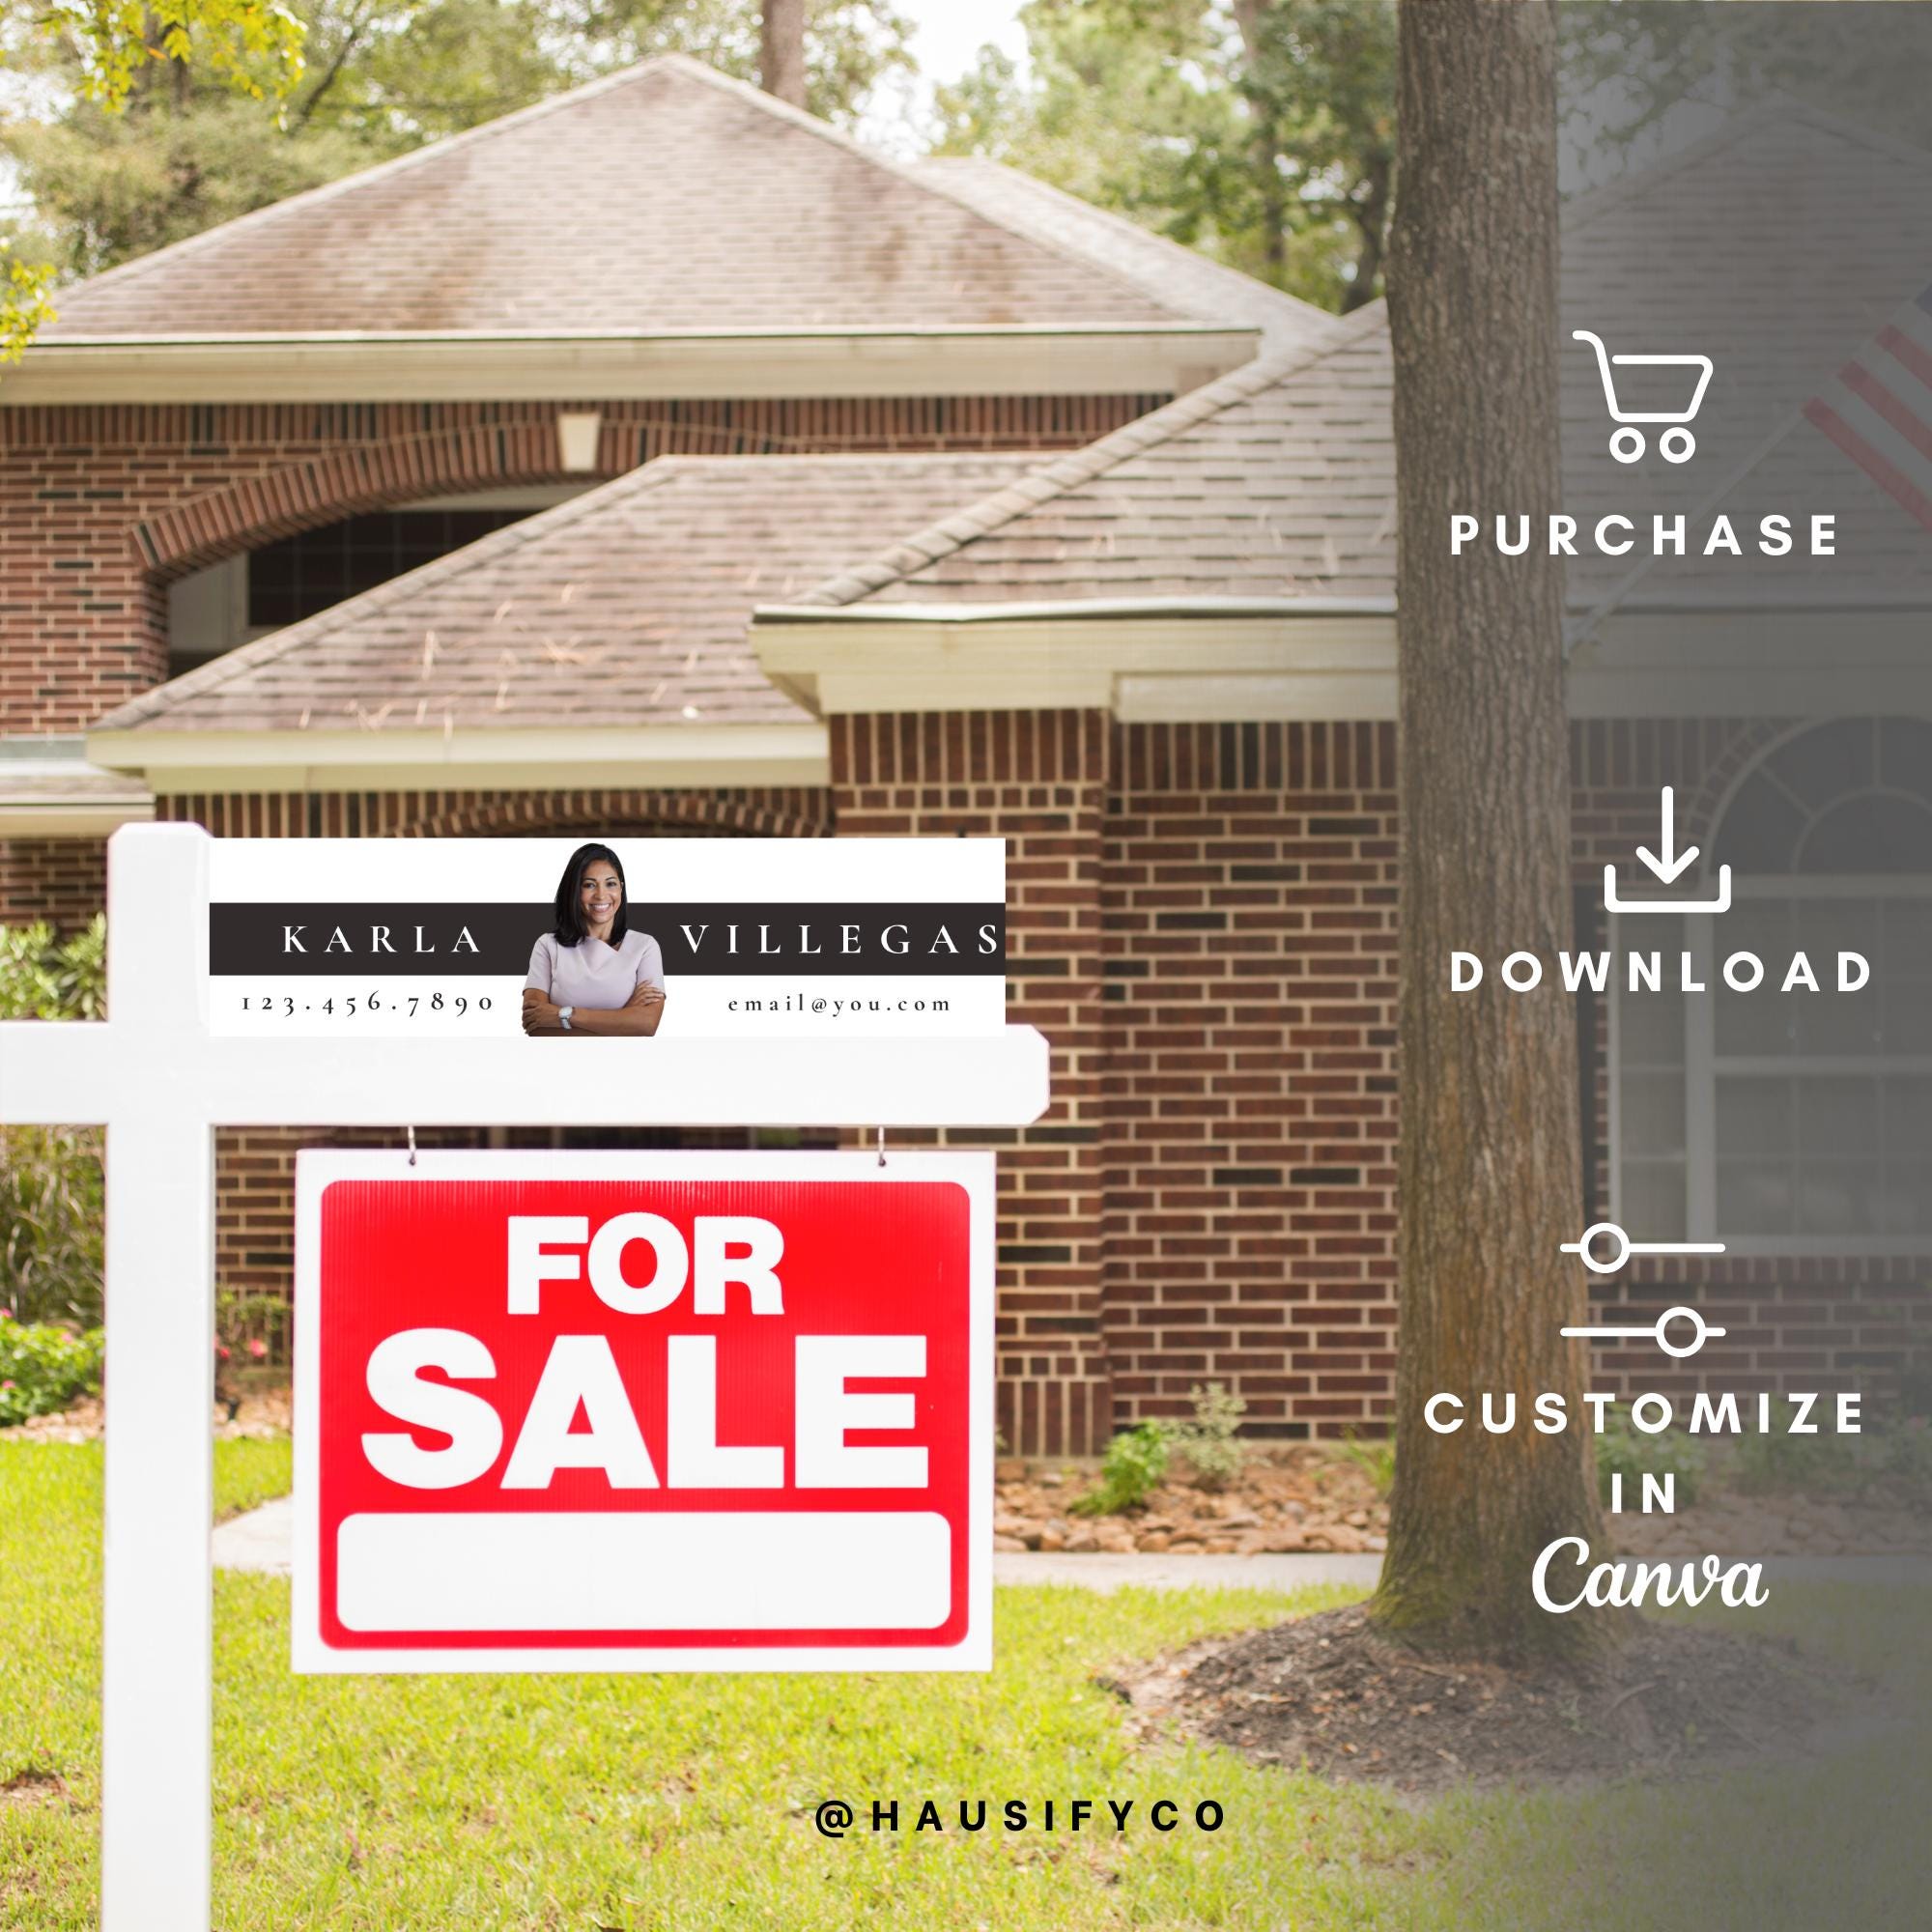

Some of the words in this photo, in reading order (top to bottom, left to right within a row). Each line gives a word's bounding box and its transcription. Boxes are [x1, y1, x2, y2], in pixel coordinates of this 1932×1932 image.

[282, 924, 481, 953] KARLA
[679, 924, 998, 954] VILLEGAS
[242, 990, 493, 1017] 123.456.7890
[727, 993, 951, 1017] email@you.com
[507, 1211, 785, 1316] FOR
[360, 1327, 929, 1490] SALE
